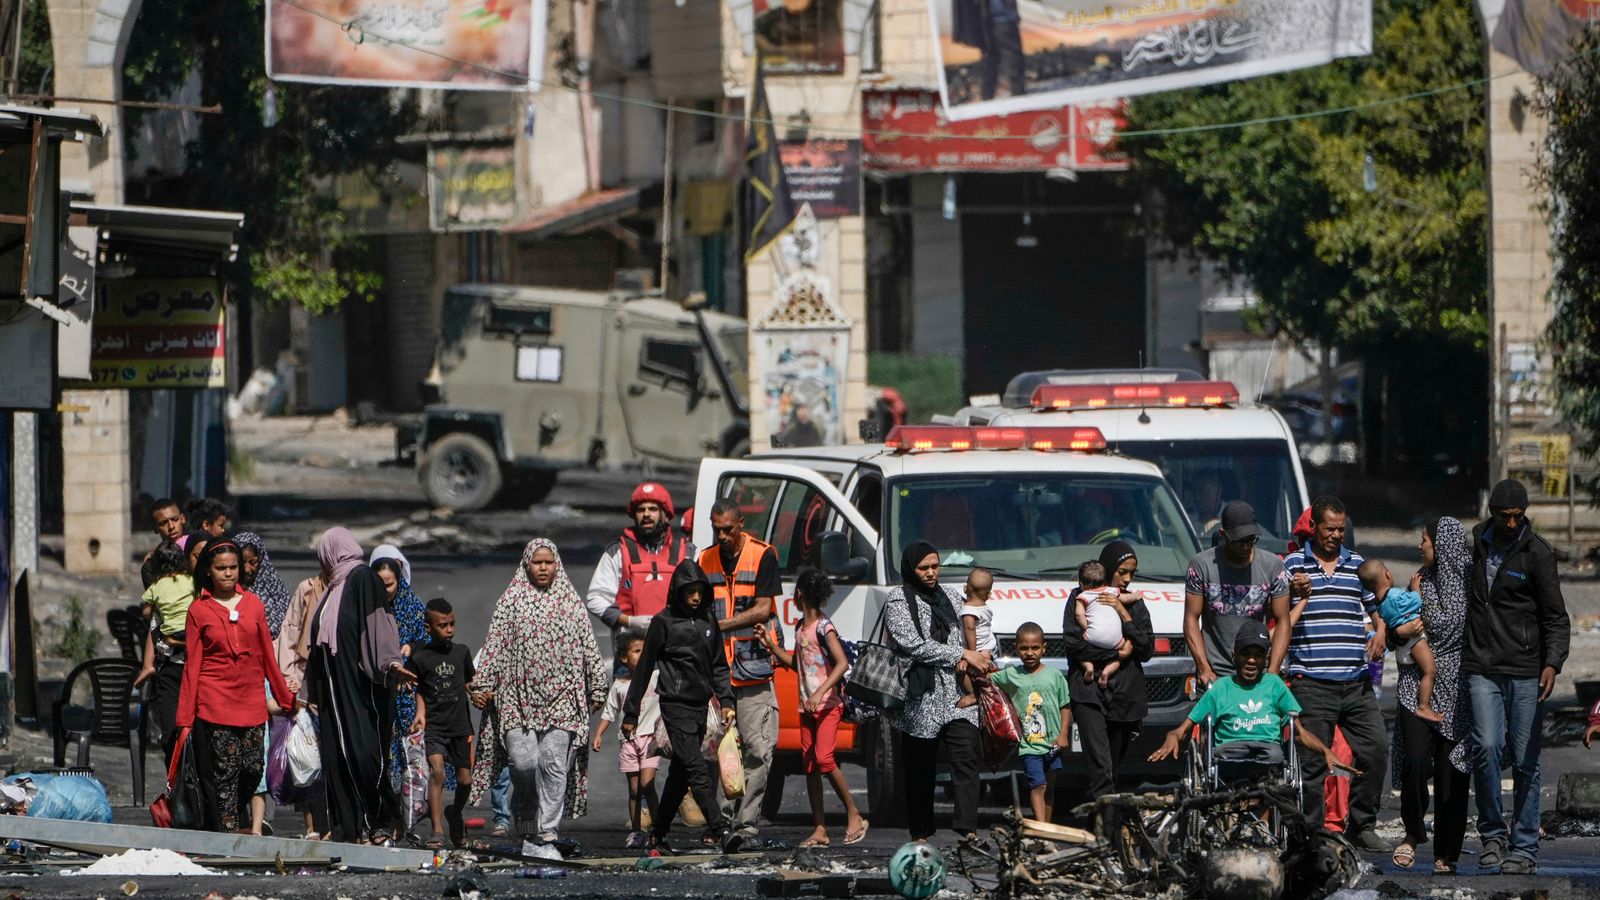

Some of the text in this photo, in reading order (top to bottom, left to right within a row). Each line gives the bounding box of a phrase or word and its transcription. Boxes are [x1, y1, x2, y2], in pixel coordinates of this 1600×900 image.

[122, 283, 215, 318] معرض
[990, 588, 1185, 603] MBUCE
[1232, 714, 1272, 732] Originals
